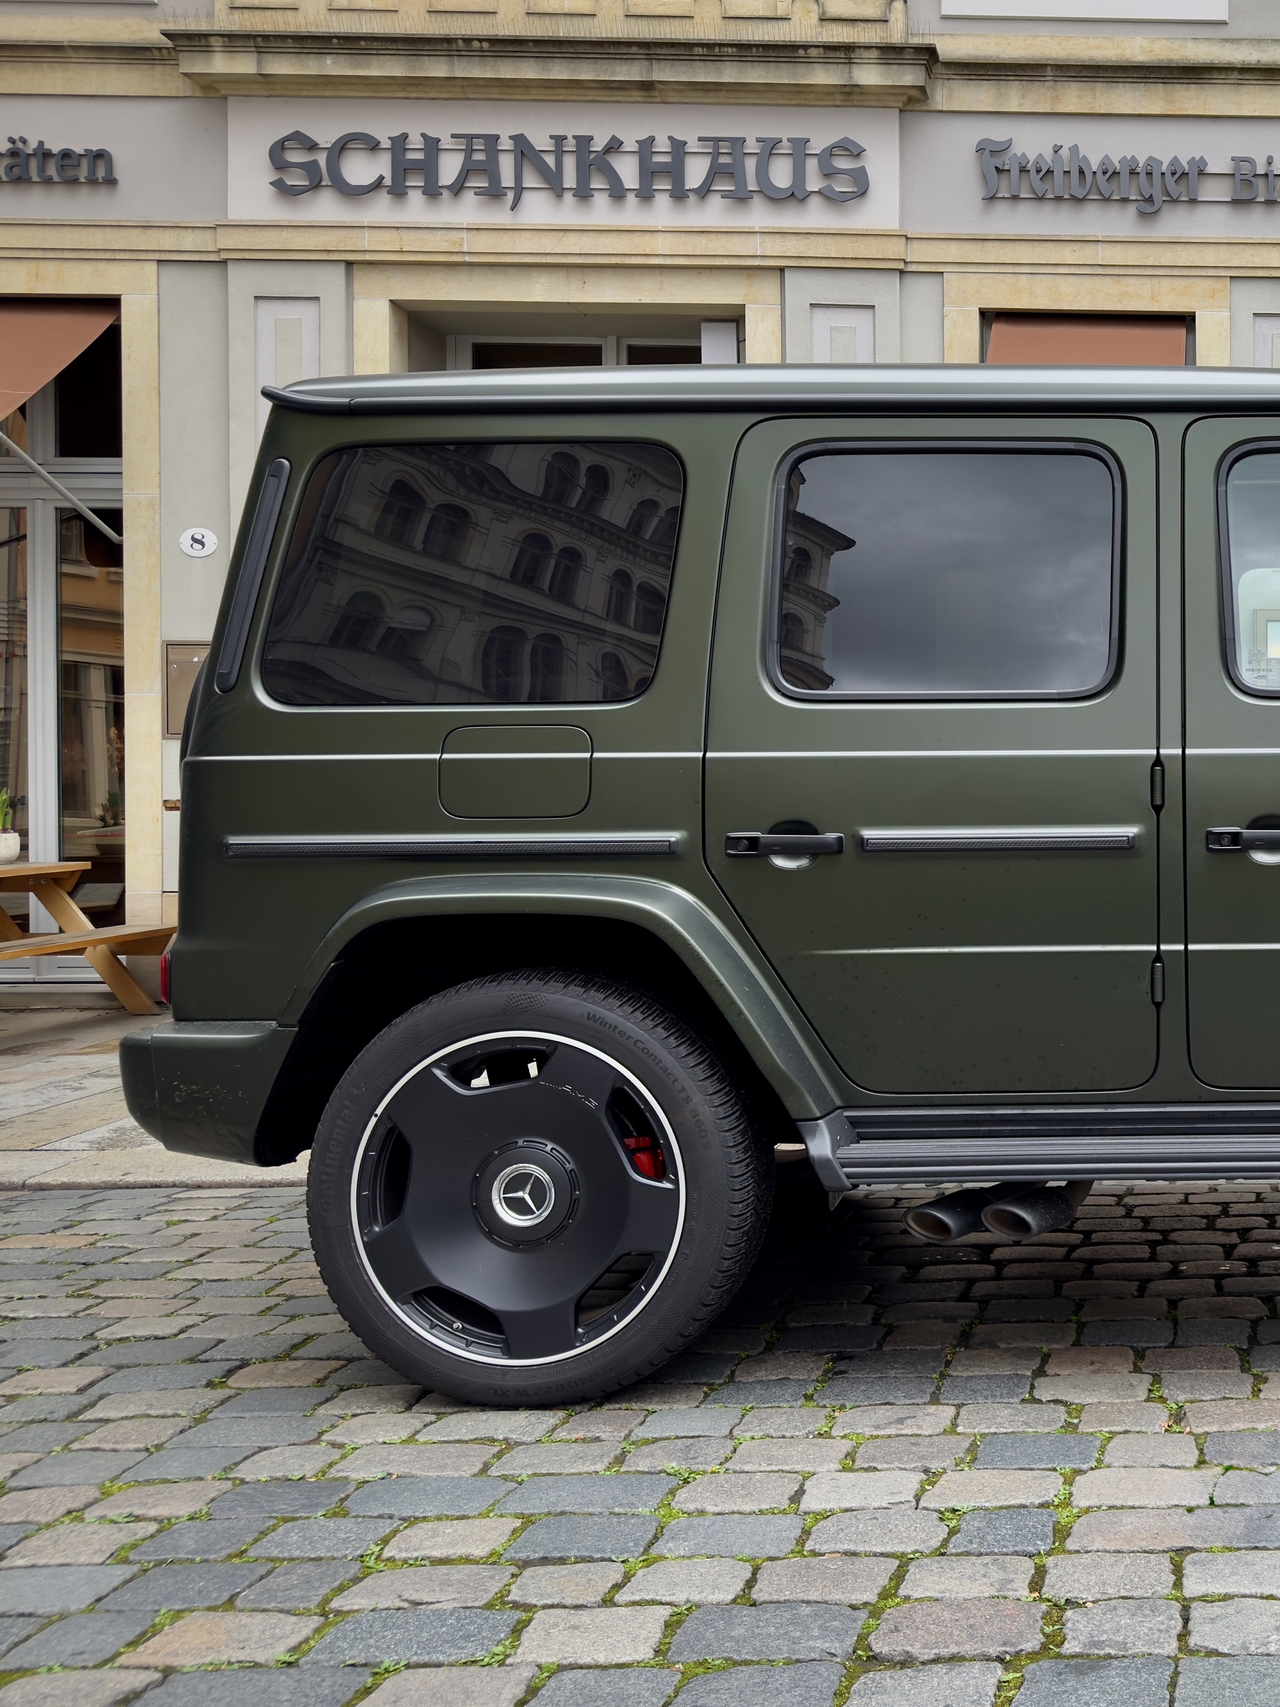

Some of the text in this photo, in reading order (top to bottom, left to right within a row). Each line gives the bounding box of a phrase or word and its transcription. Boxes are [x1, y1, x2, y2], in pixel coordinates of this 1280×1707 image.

[0, 135, 118, 183] äten
[268, 129, 871, 212] SCHANKHAUS
[975, 137, 1208, 215] Freiberger
[190, 532, 206, 551] 8
[677, 1084, 693, 1106] TS
